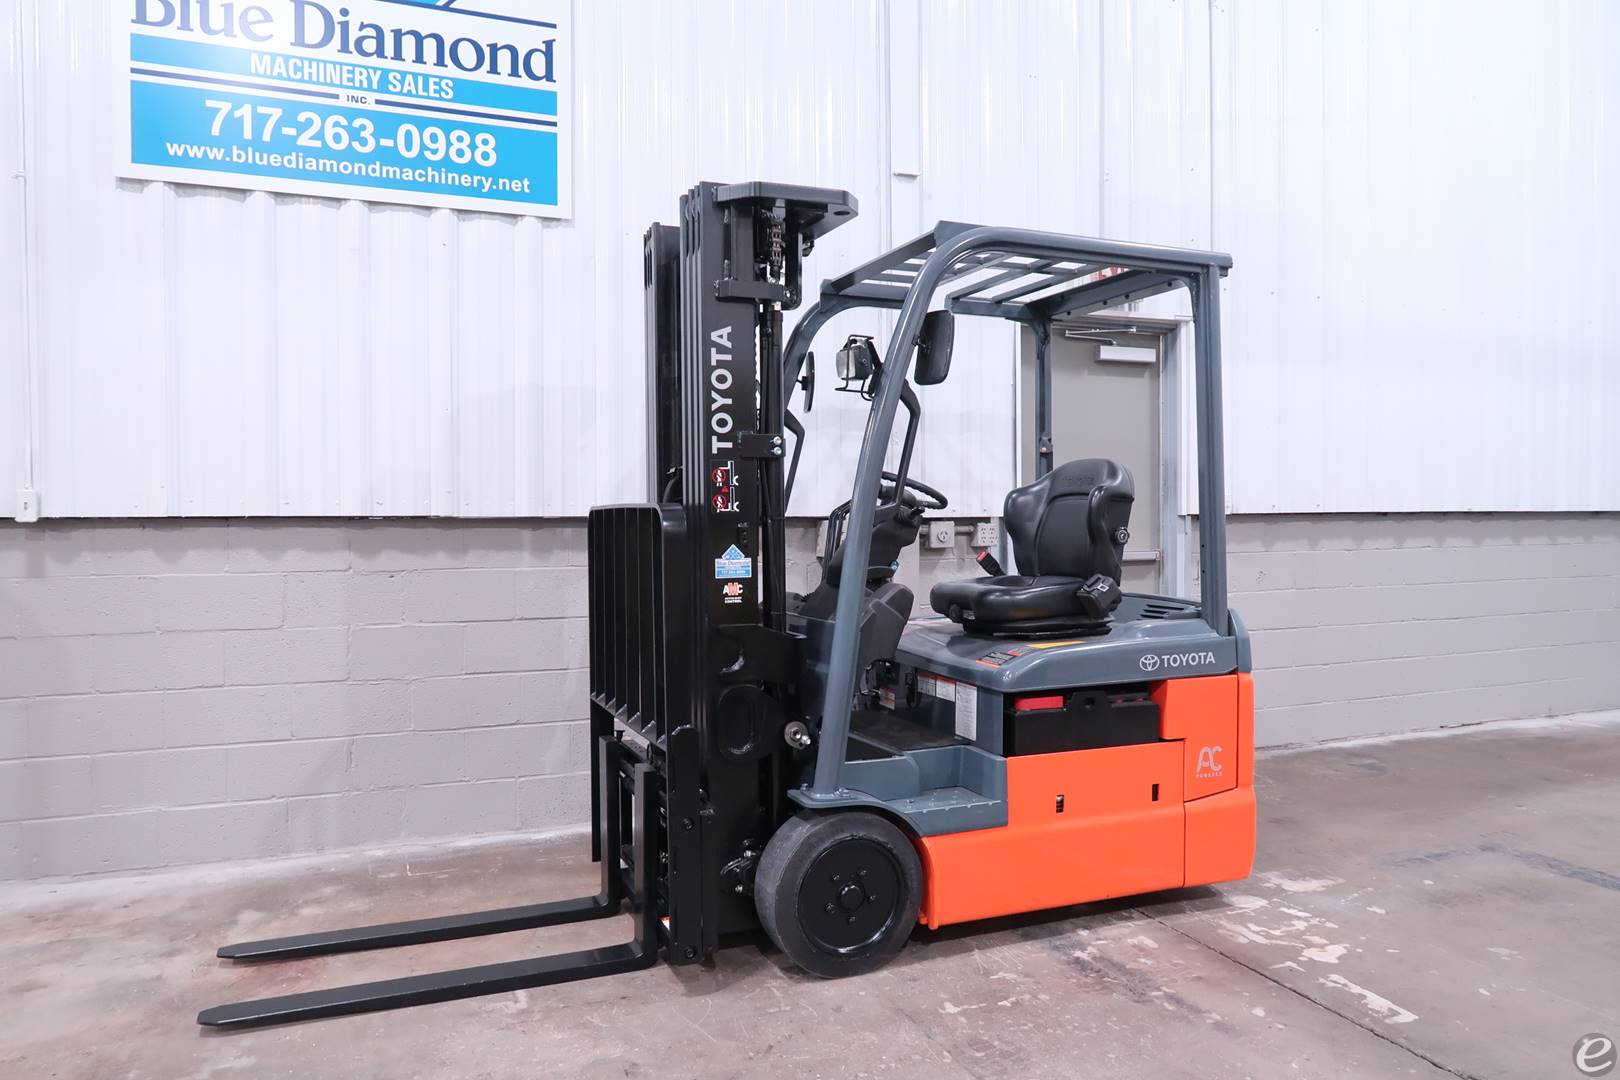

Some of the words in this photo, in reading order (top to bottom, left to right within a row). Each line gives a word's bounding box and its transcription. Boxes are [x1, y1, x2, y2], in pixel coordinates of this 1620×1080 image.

[290, 0, 557, 83] Diamond
[250, 53, 382, 91] MACHINERY
[387, 71, 454, 99] SALES
[346, 94, 371, 105] INC.
[204, 99, 498, 167] 717-263-0988
[166, 142, 531, 193] www.bluediamondmachinery.net
[711, 326, 733, 454] TOYOTA
[1161, 651, 1216, 668] TOYOTA
